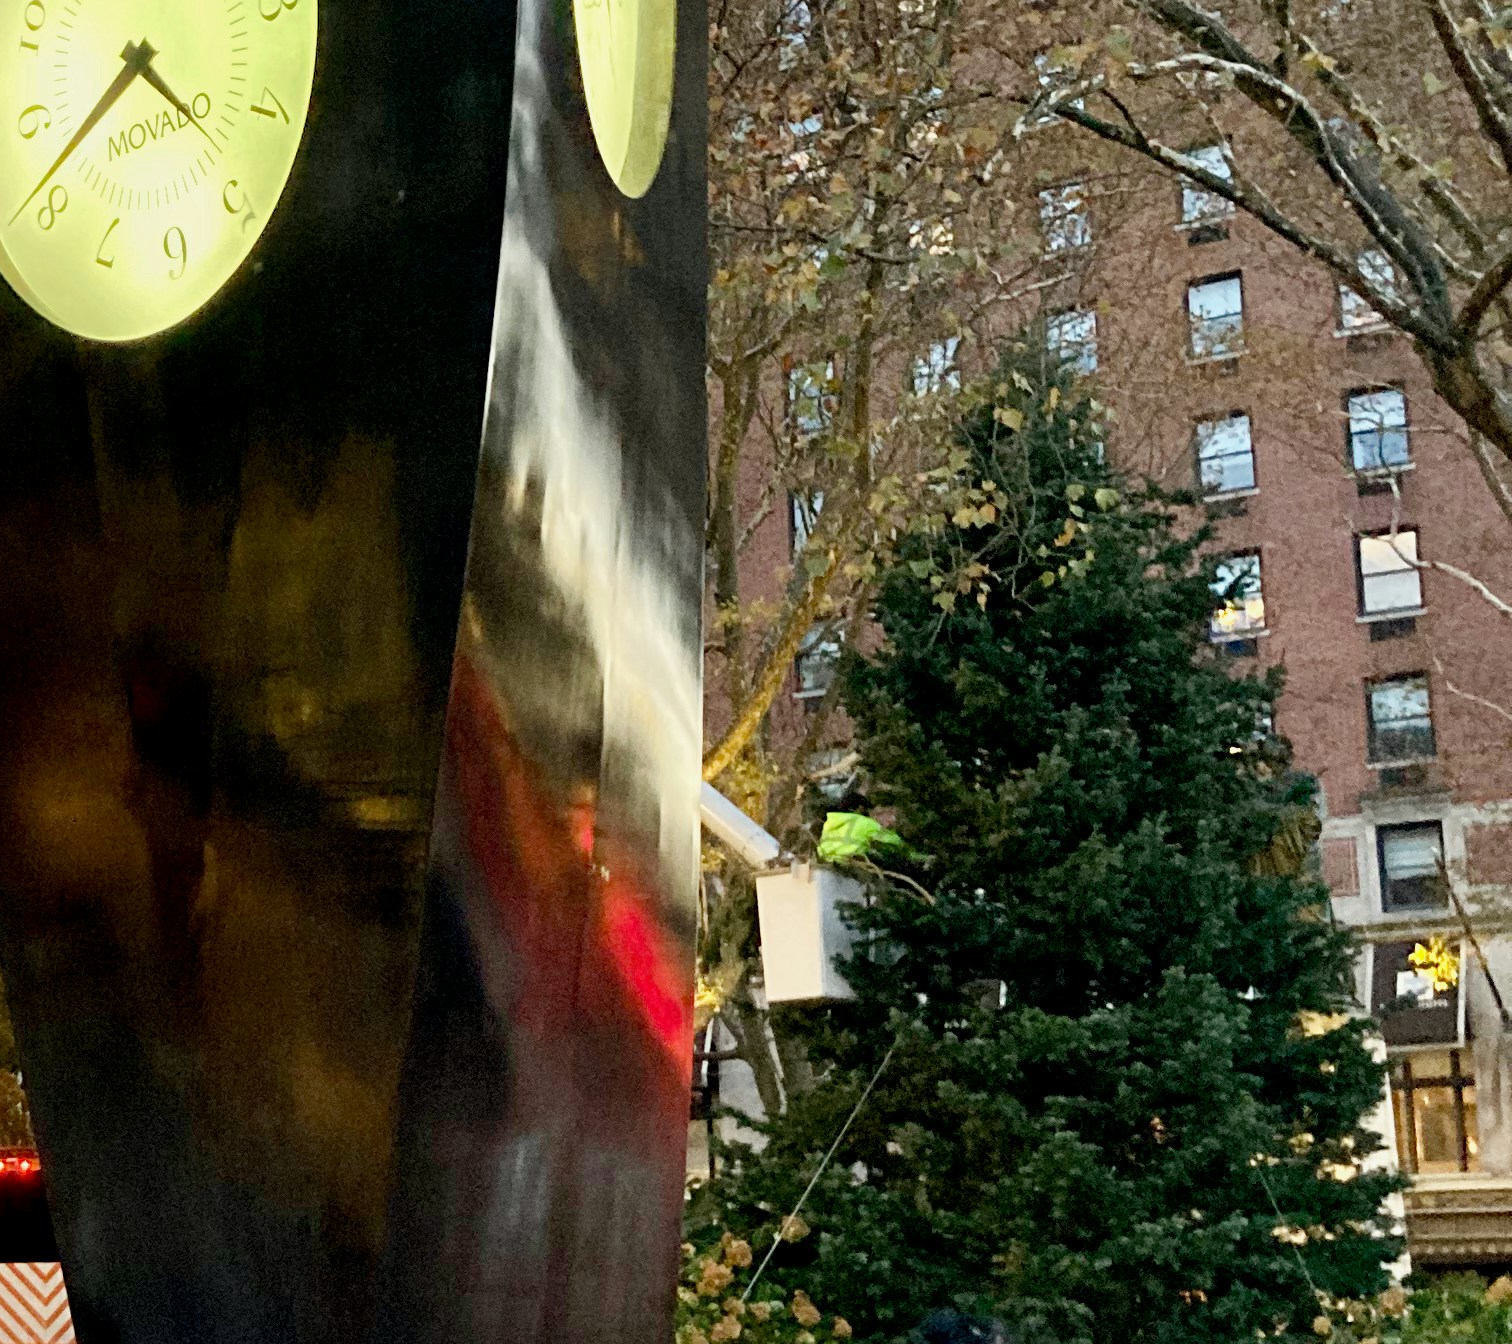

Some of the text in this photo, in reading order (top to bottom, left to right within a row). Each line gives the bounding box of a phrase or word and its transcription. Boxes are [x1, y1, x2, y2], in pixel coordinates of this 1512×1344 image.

[18, 0, 46, 57] 10
[17, 104, 52, 140] 9
[107, 93, 211, 162] MOVADO
[249, 86, 290, 126] 4
[37, 184, 69, 231] 8
[222, 178, 256, 234] 5
[95, 217, 120, 269] 7
[163, 226, 187, 280] 6
